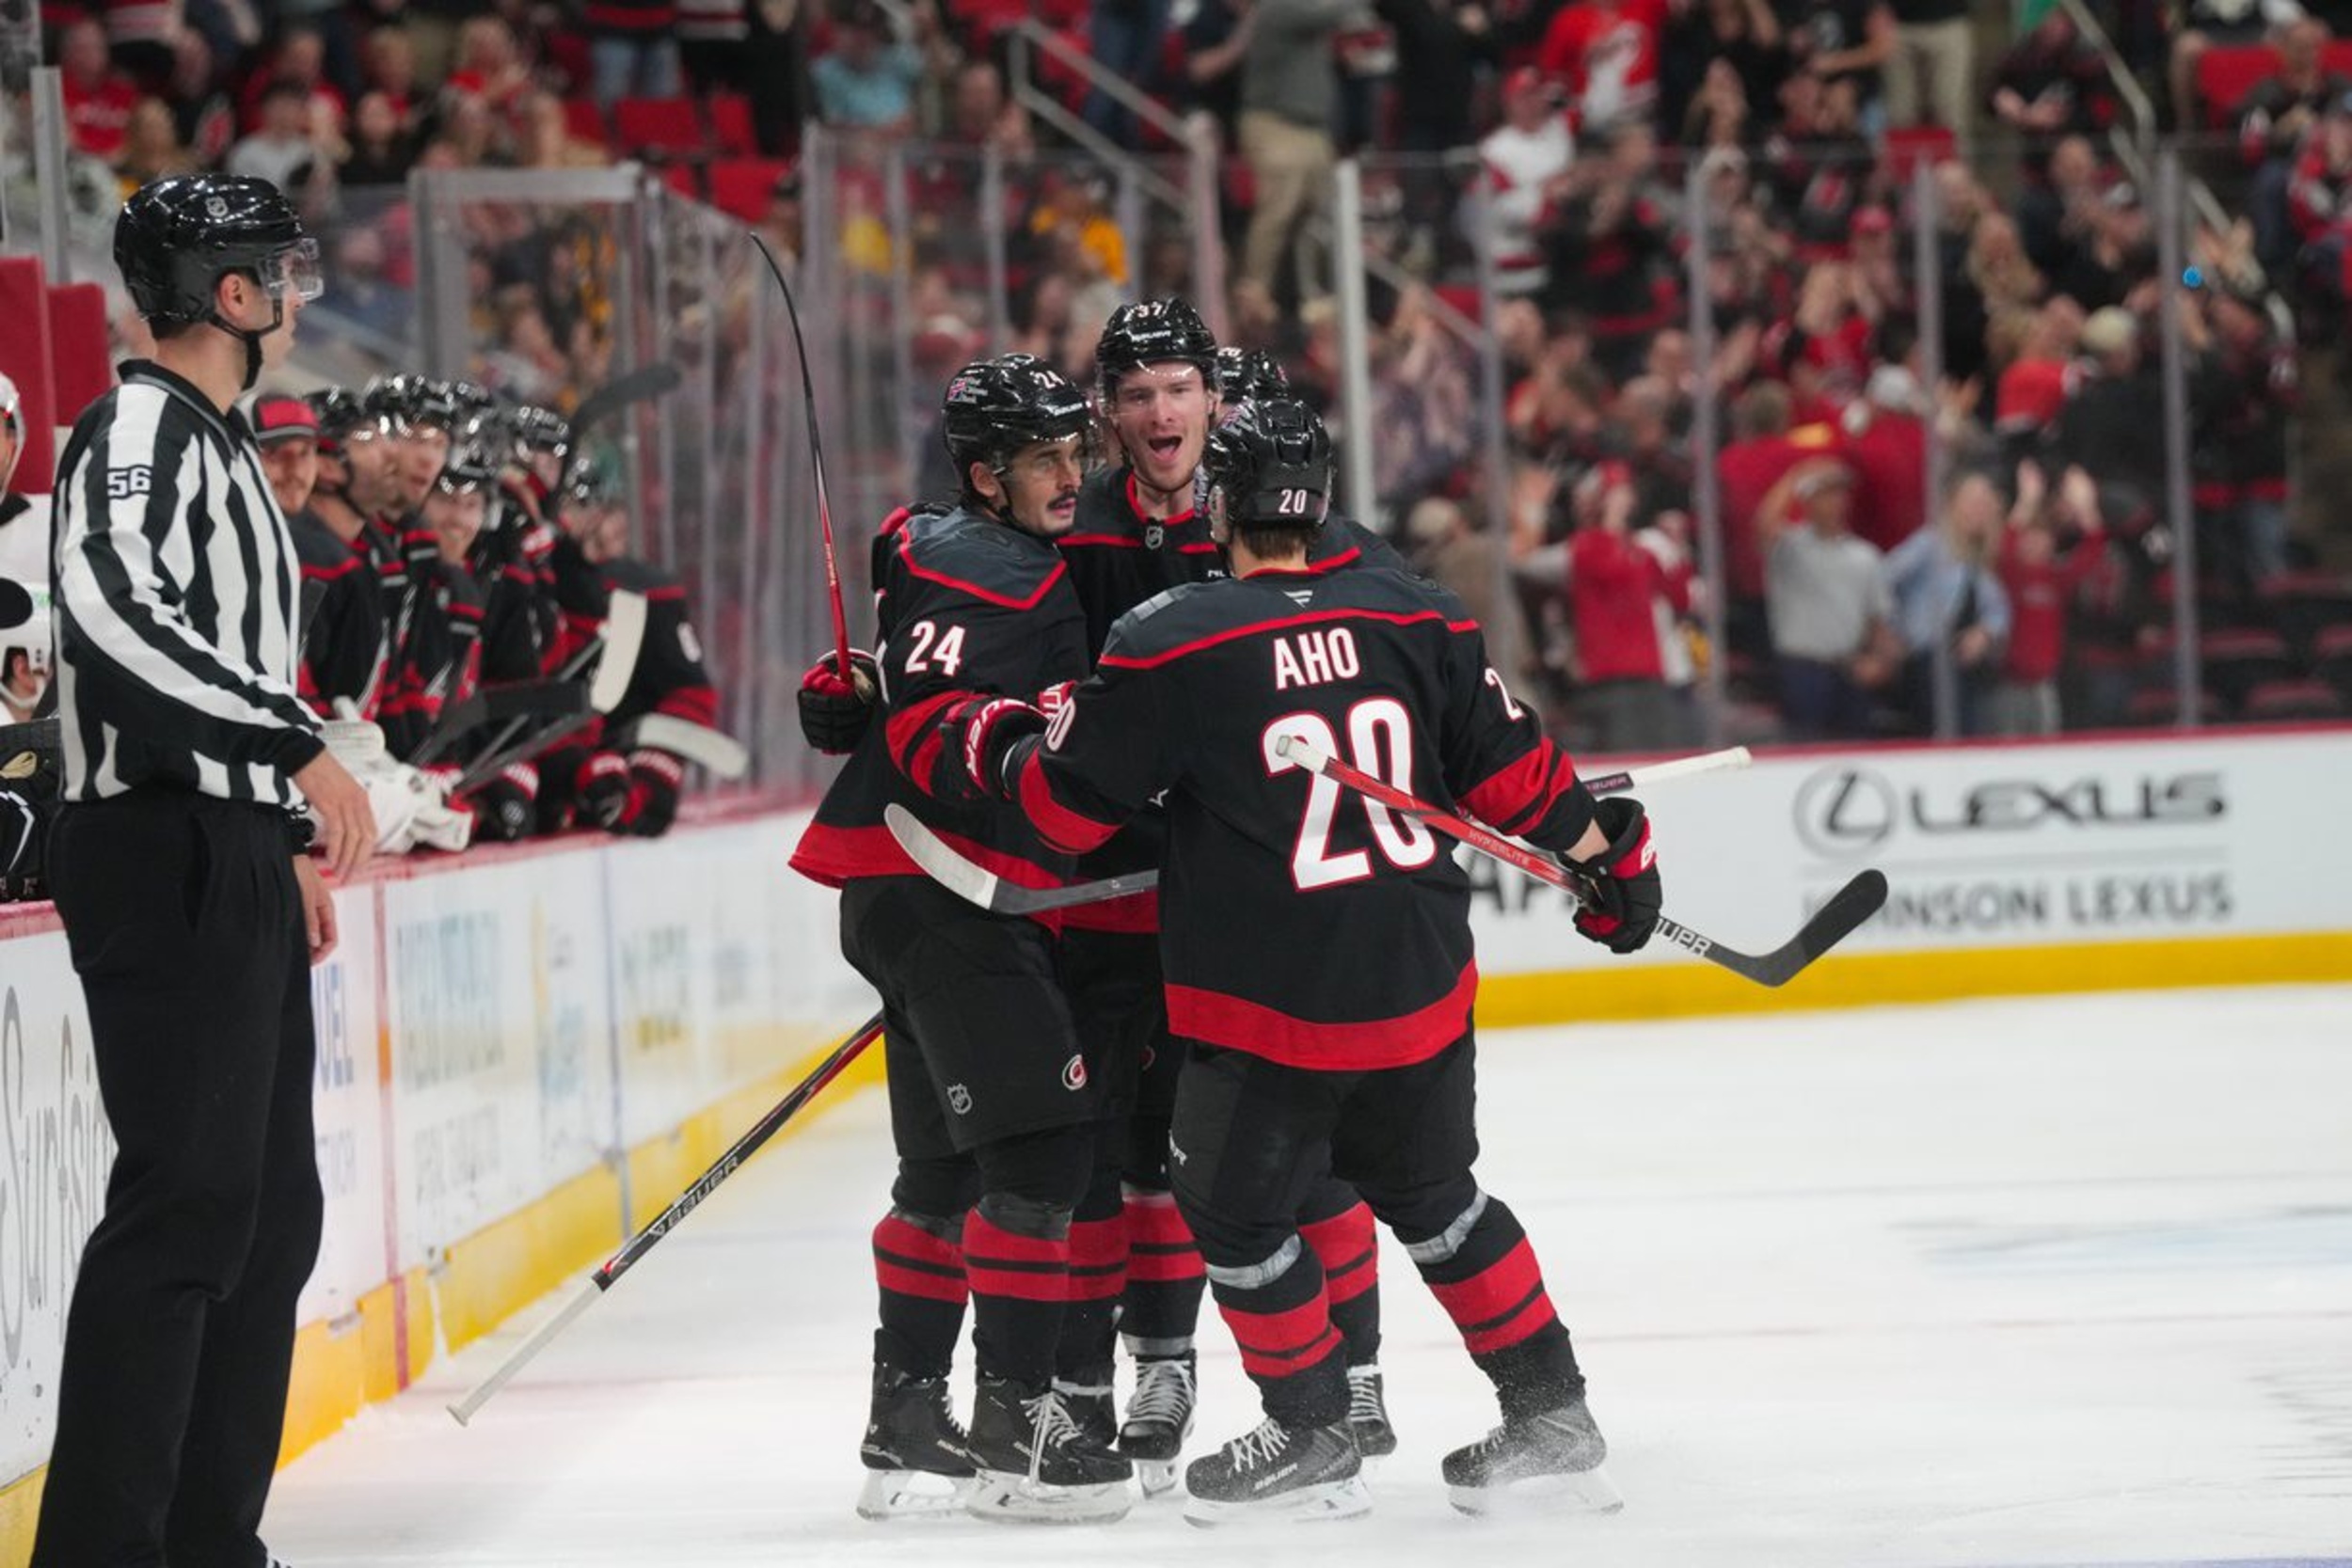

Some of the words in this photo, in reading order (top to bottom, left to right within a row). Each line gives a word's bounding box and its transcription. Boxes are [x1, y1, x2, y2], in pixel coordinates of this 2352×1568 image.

[1136, 300, 1163, 318] 37
[107, 466, 151, 497] 56
[1279, 488, 1307, 514] 20
[904, 620, 966, 676] 24
[1273, 627, 1360, 690] AHO
[1045, 694, 1075, 752] 0
[1261, 696, 1438, 893] 20
[1909, 769, 2228, 836] LEXUS
[2066, 870, 2235, 926] LEXUS
[666, 1155, 739, 1228] BAUER
